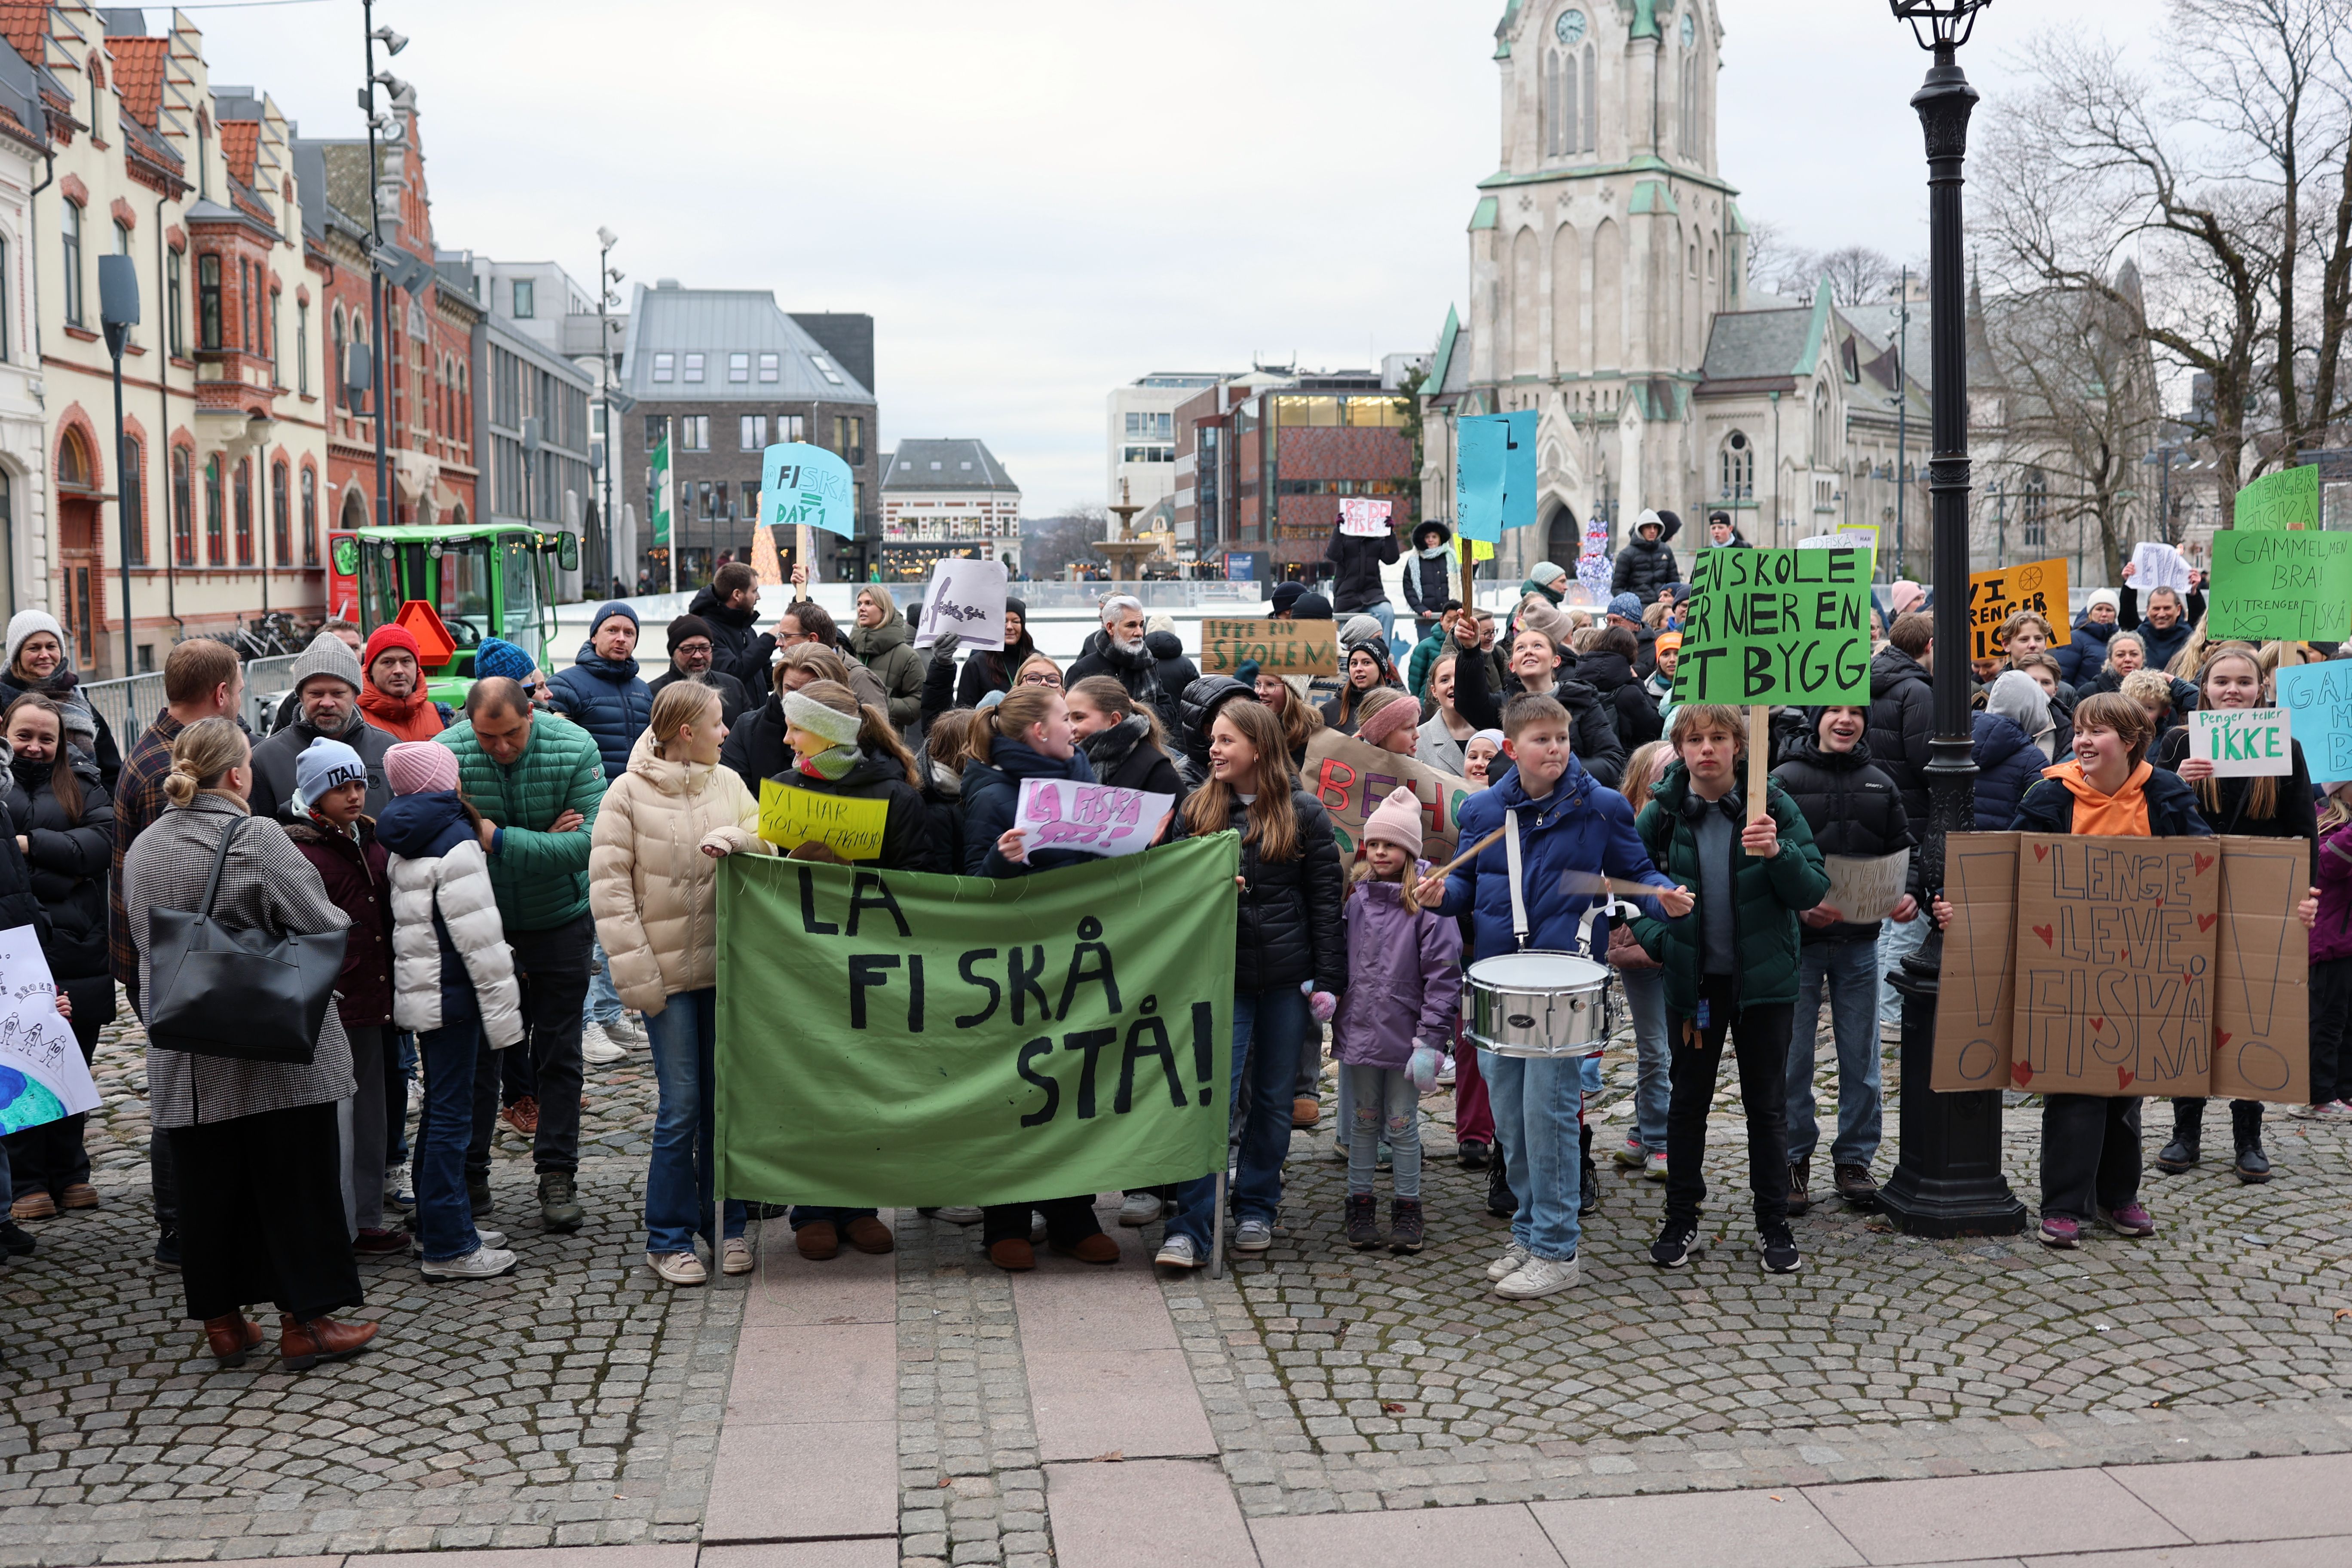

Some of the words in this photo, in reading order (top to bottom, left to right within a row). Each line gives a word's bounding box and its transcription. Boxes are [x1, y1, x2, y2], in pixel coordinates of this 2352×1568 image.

[2251, 467, 2316, 509] TRENGER
[776, 503, 812, 523] DAY
[818, 508, 825, 525] 1
[1730, 548, 1855, 586] SKOLE
[2329, 539, 2348, 556] MEN
[2272, 564, 2323, 590] BRA!
[1681, 595, 1711, 647] ER
[1724, 593, 1800, 639] MER
[1815, 591, 1861, 632] EN
[1969, 591, 2047, 627] RENGER
[2243, 599, 2299, 612] TRENGER
[1209, 620, 1256, 638] IKKE
[1671, 647, 1727, 703] ET
[1744, 638, 1866, 698] BYGG
[2288, 668, 2352, 709] GA
[2199, 712, 2244, 728] Penger
[2251, 710, 2283, 721] teller
[766, 782, 791, 813] VI
[806, 795, 849, 824] HAR
[1026, 781, 1062, 822] LA
[1073, 786, 1145, 825] FISKÅ
[2053, 843, 2194, 906] LENGE
[797, 866, 912, 936] LA
[2061, 905, 2193, 974] LEVE
[848, 915, 1123, 1033] FISKÅ
[2027, 955, 2208, 1082] FISKÅ
[1017, 994, 1213, 1128] STÅ!
